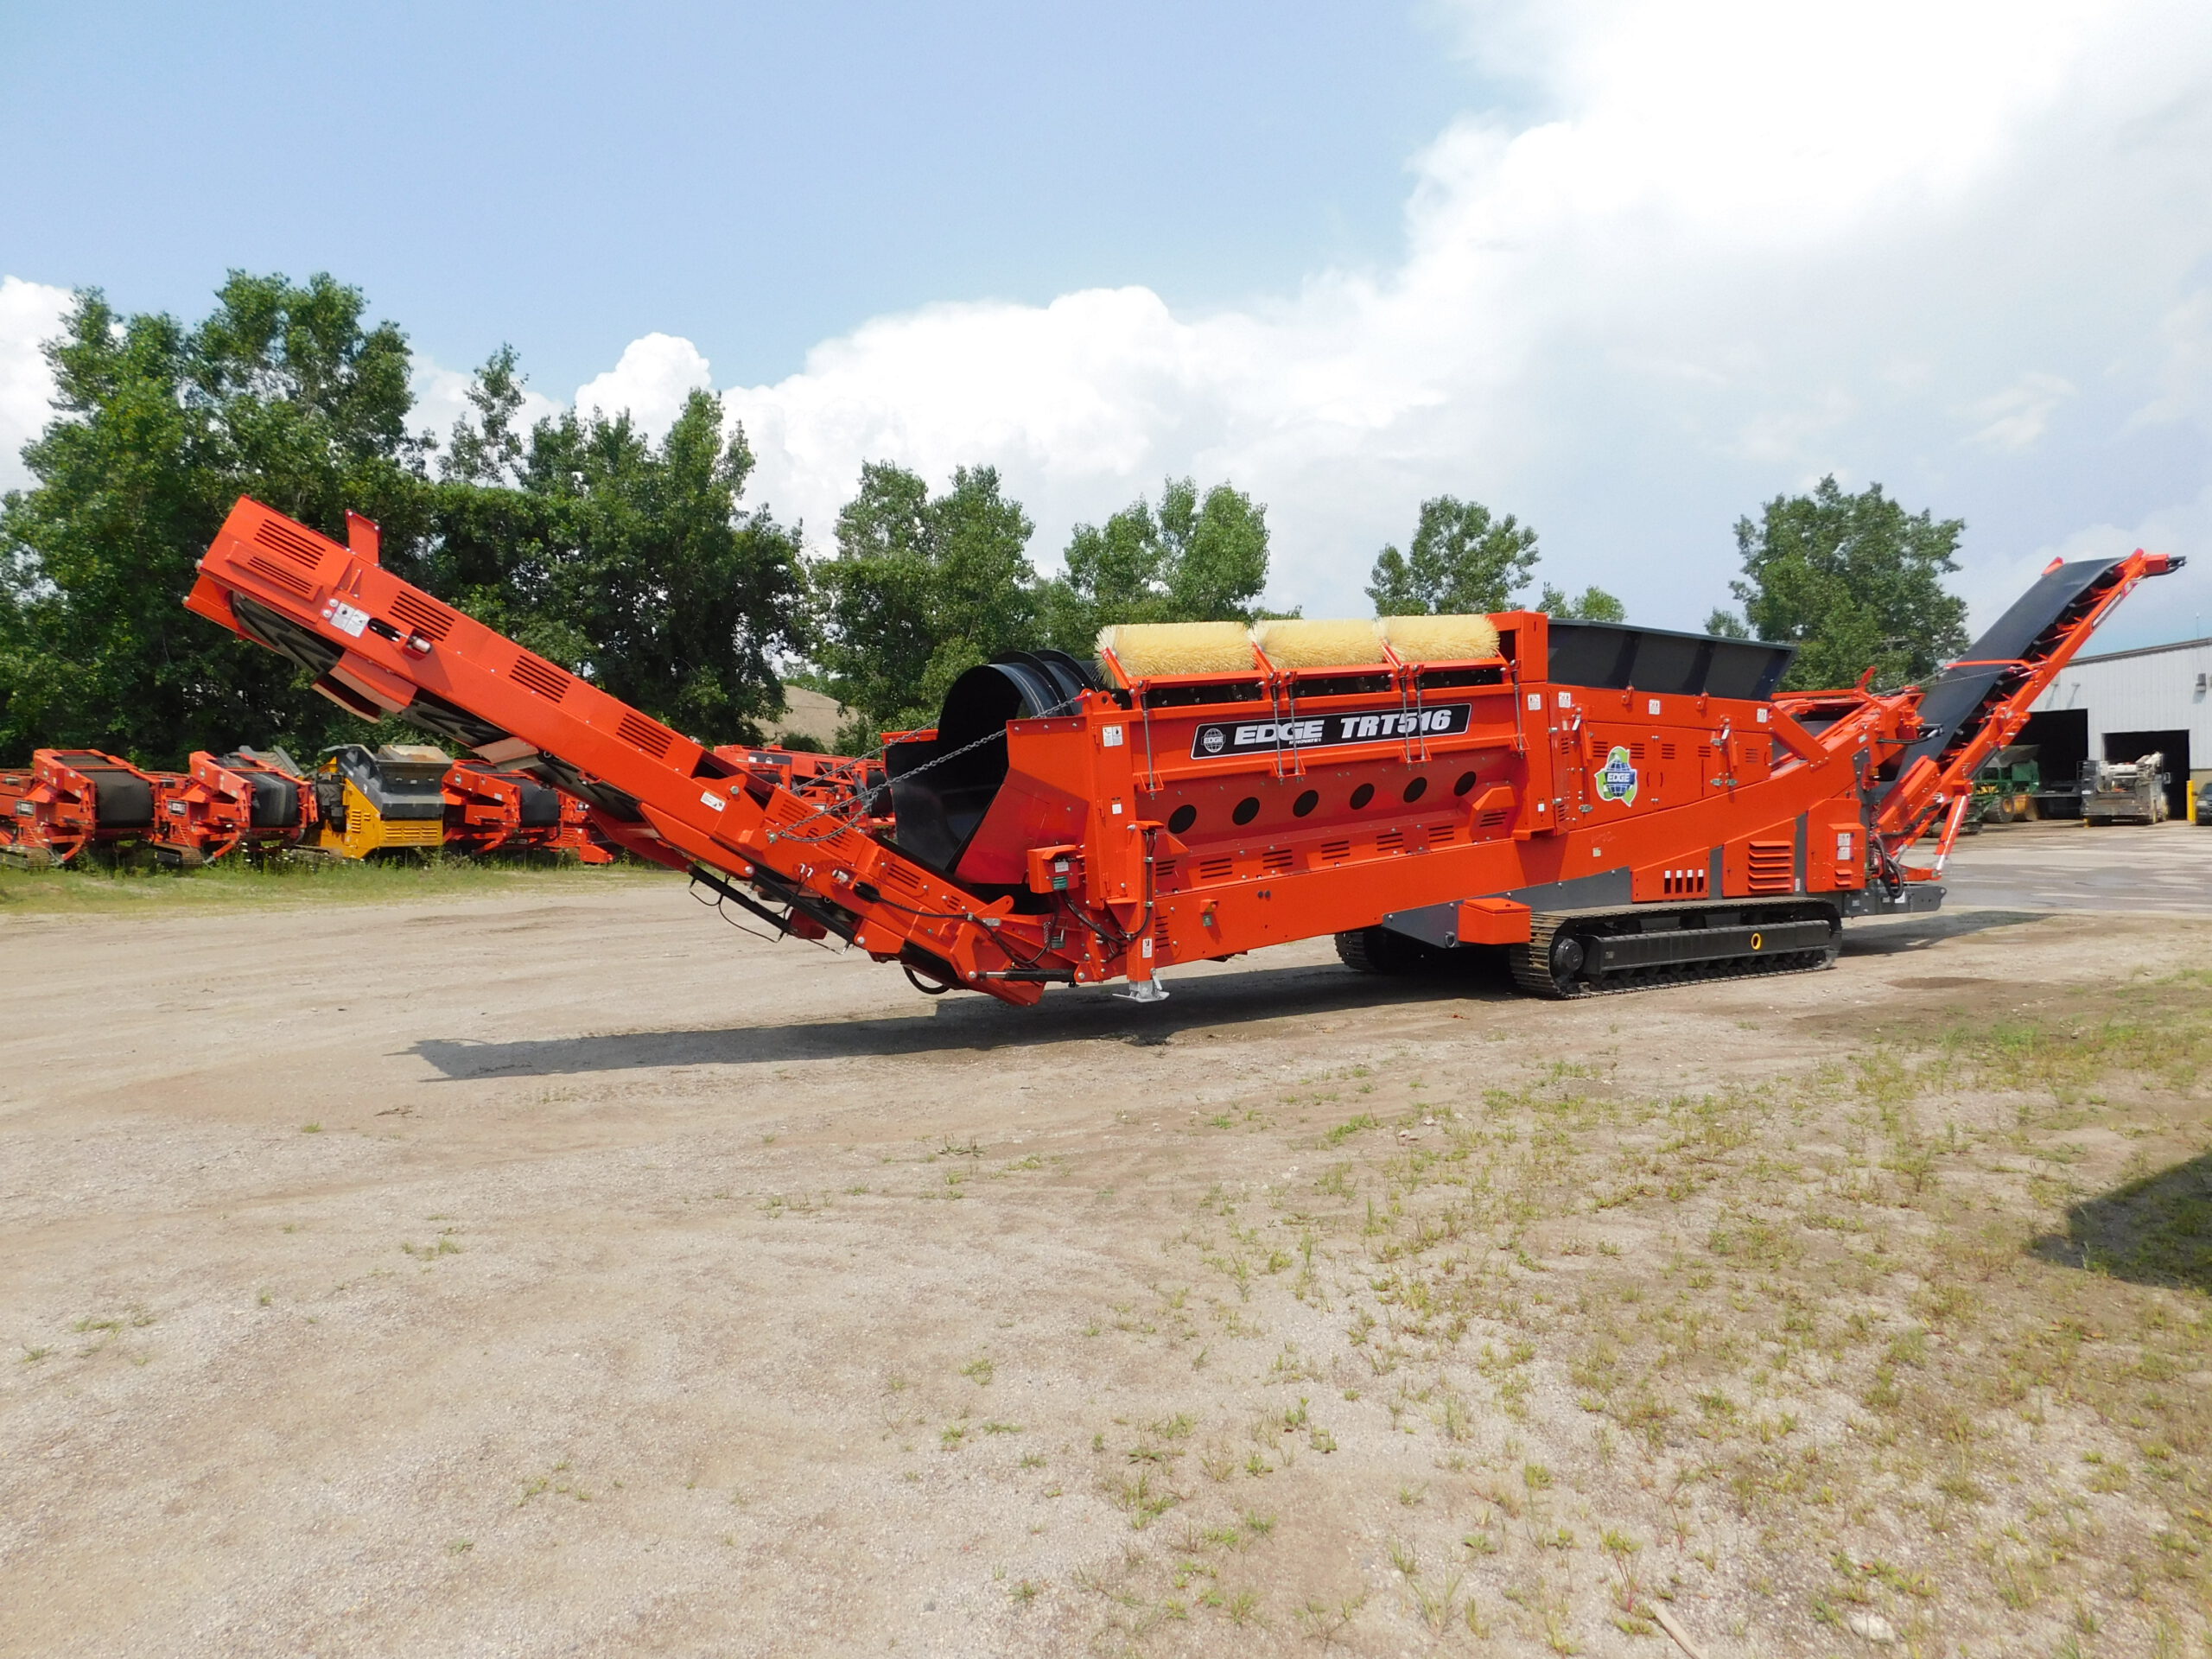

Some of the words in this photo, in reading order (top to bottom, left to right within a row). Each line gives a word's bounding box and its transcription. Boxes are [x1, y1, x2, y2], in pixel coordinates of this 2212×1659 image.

[1234, 720, 1325, 745] EDGE
[1340, 709, 1452, 739] TRT516
[1607, 772, 1630, 783] EDGE
